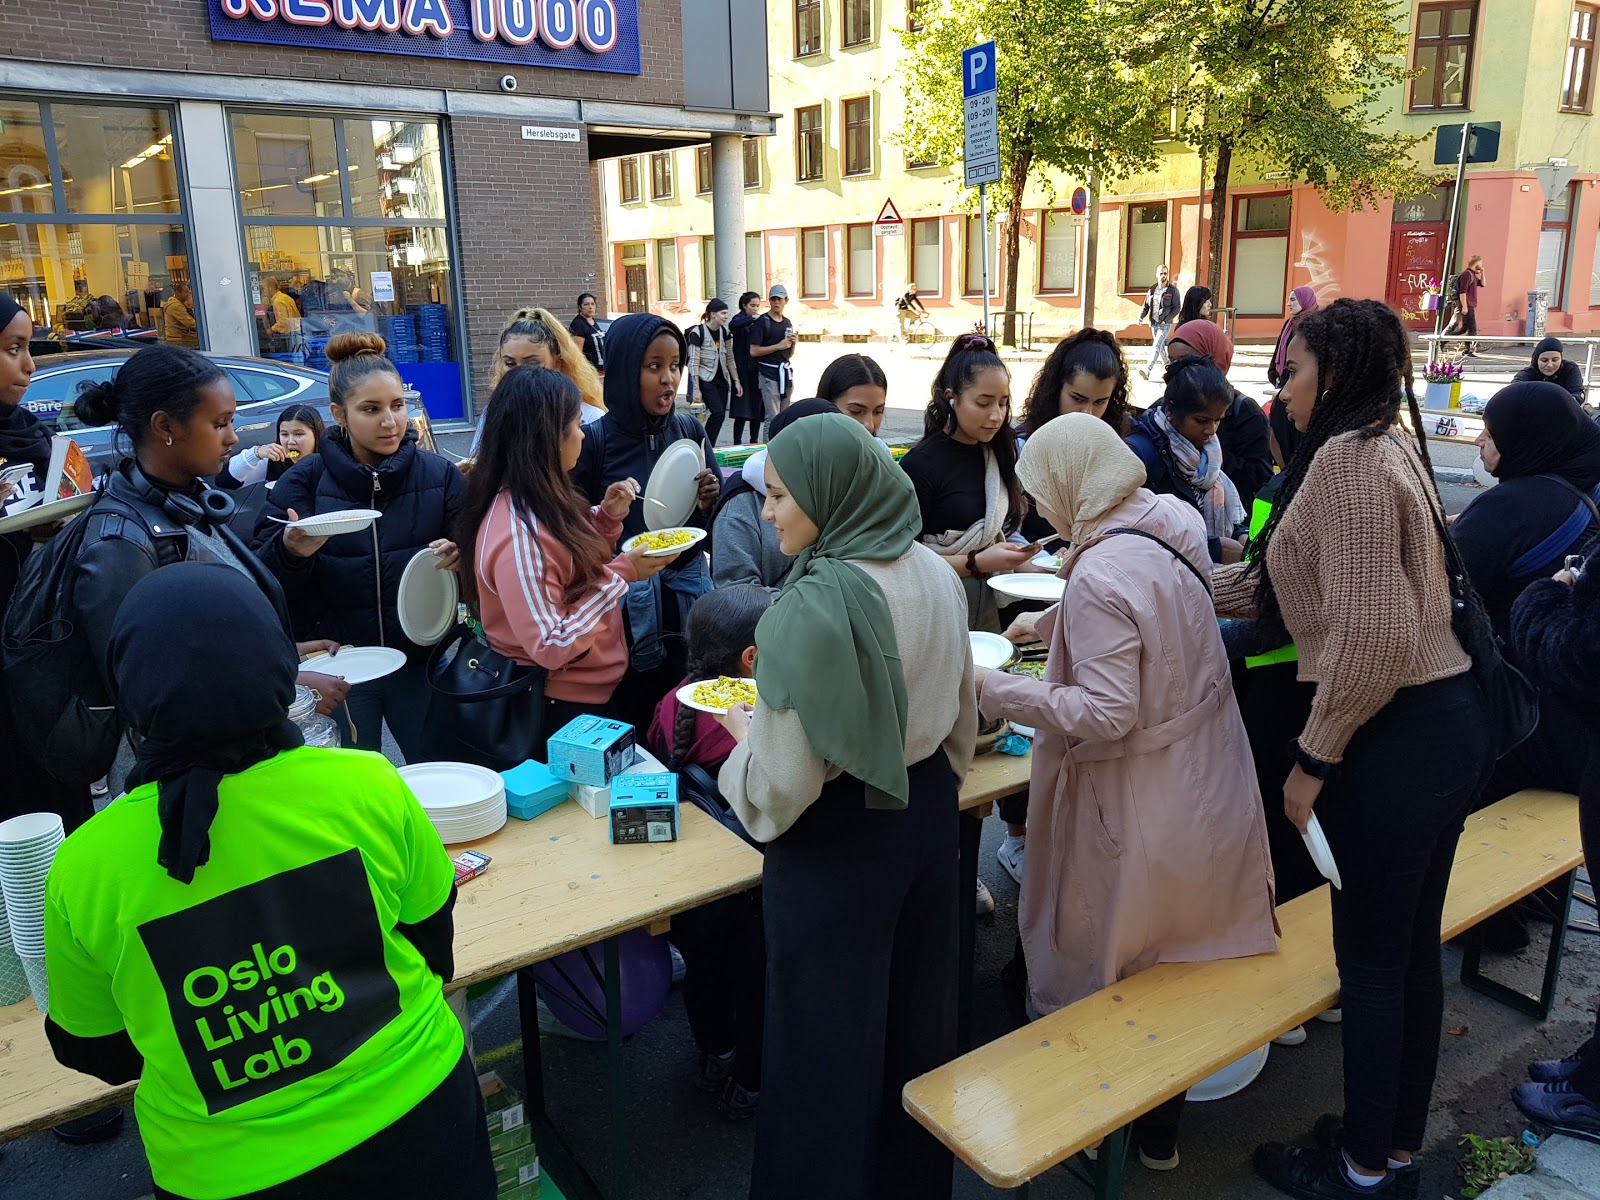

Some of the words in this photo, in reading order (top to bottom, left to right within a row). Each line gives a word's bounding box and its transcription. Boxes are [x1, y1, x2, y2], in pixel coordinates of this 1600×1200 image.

[471, 0, 618, 53] 1000
[970, 51, 988, 90] P
[526, 129, 576, 140] Herslebsgate
[28, 401, 62, 413] Bare
[183, 942, 297, 1007] Oslo
[195, 971, 345, 1051] Living
[212, 1034, 312, 1090] Lab
